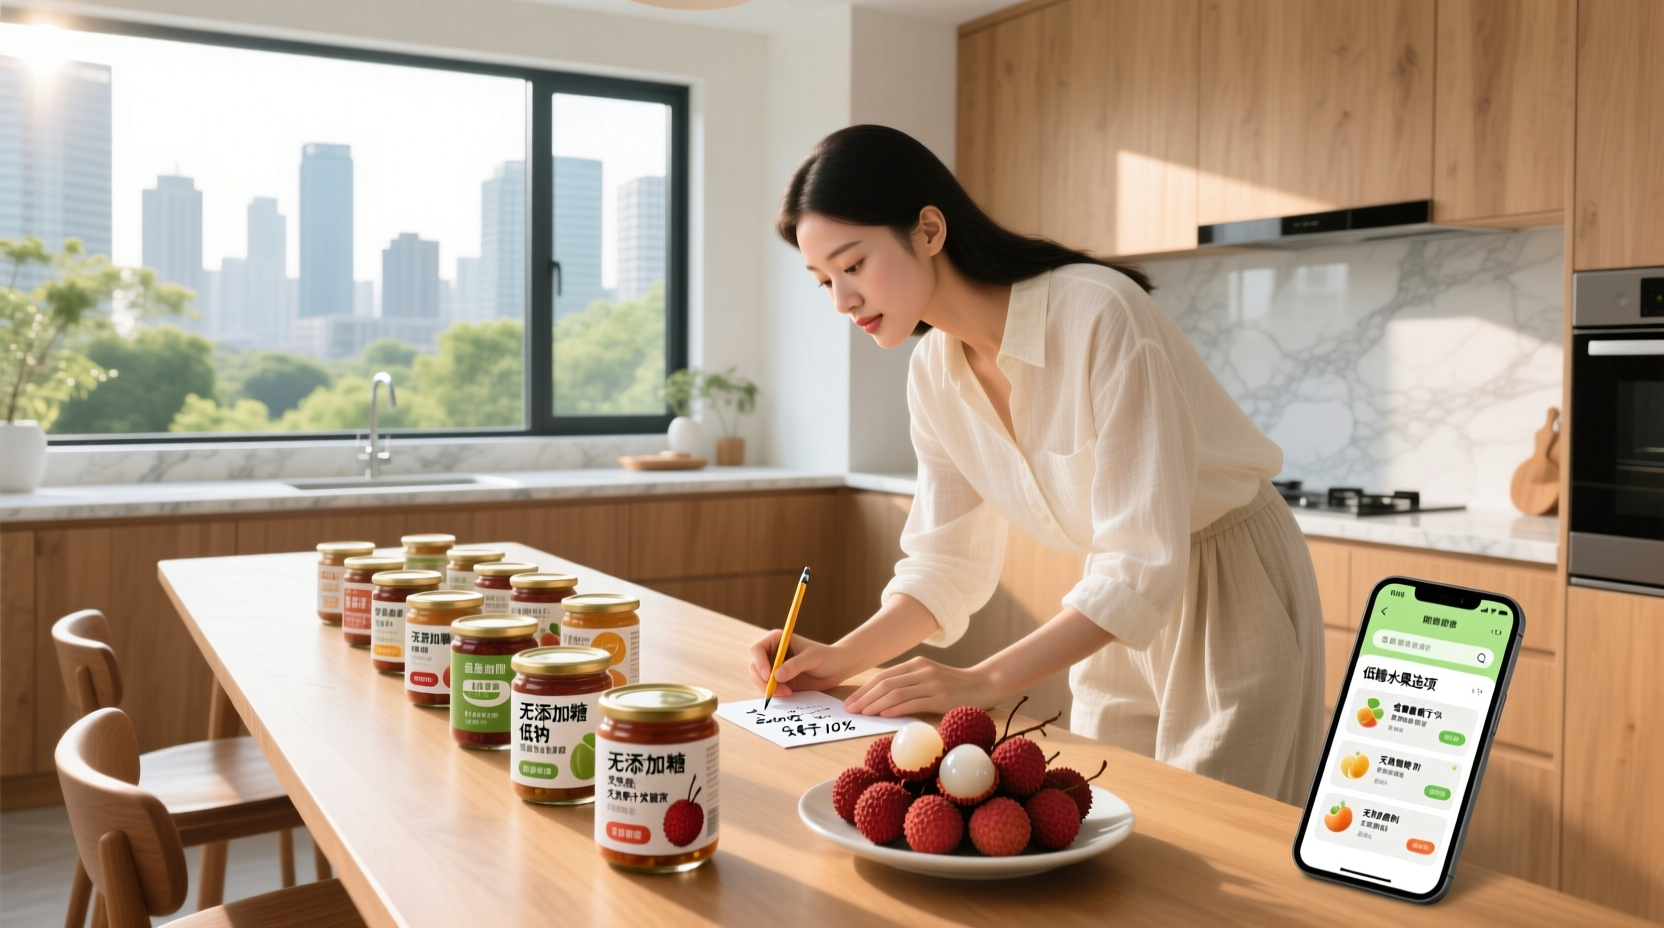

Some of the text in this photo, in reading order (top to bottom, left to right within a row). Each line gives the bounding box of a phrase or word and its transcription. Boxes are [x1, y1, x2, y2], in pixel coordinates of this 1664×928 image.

[519, 702, 588, 722] 无添加糖
[608, 751, 686, 775] 无添加糖
